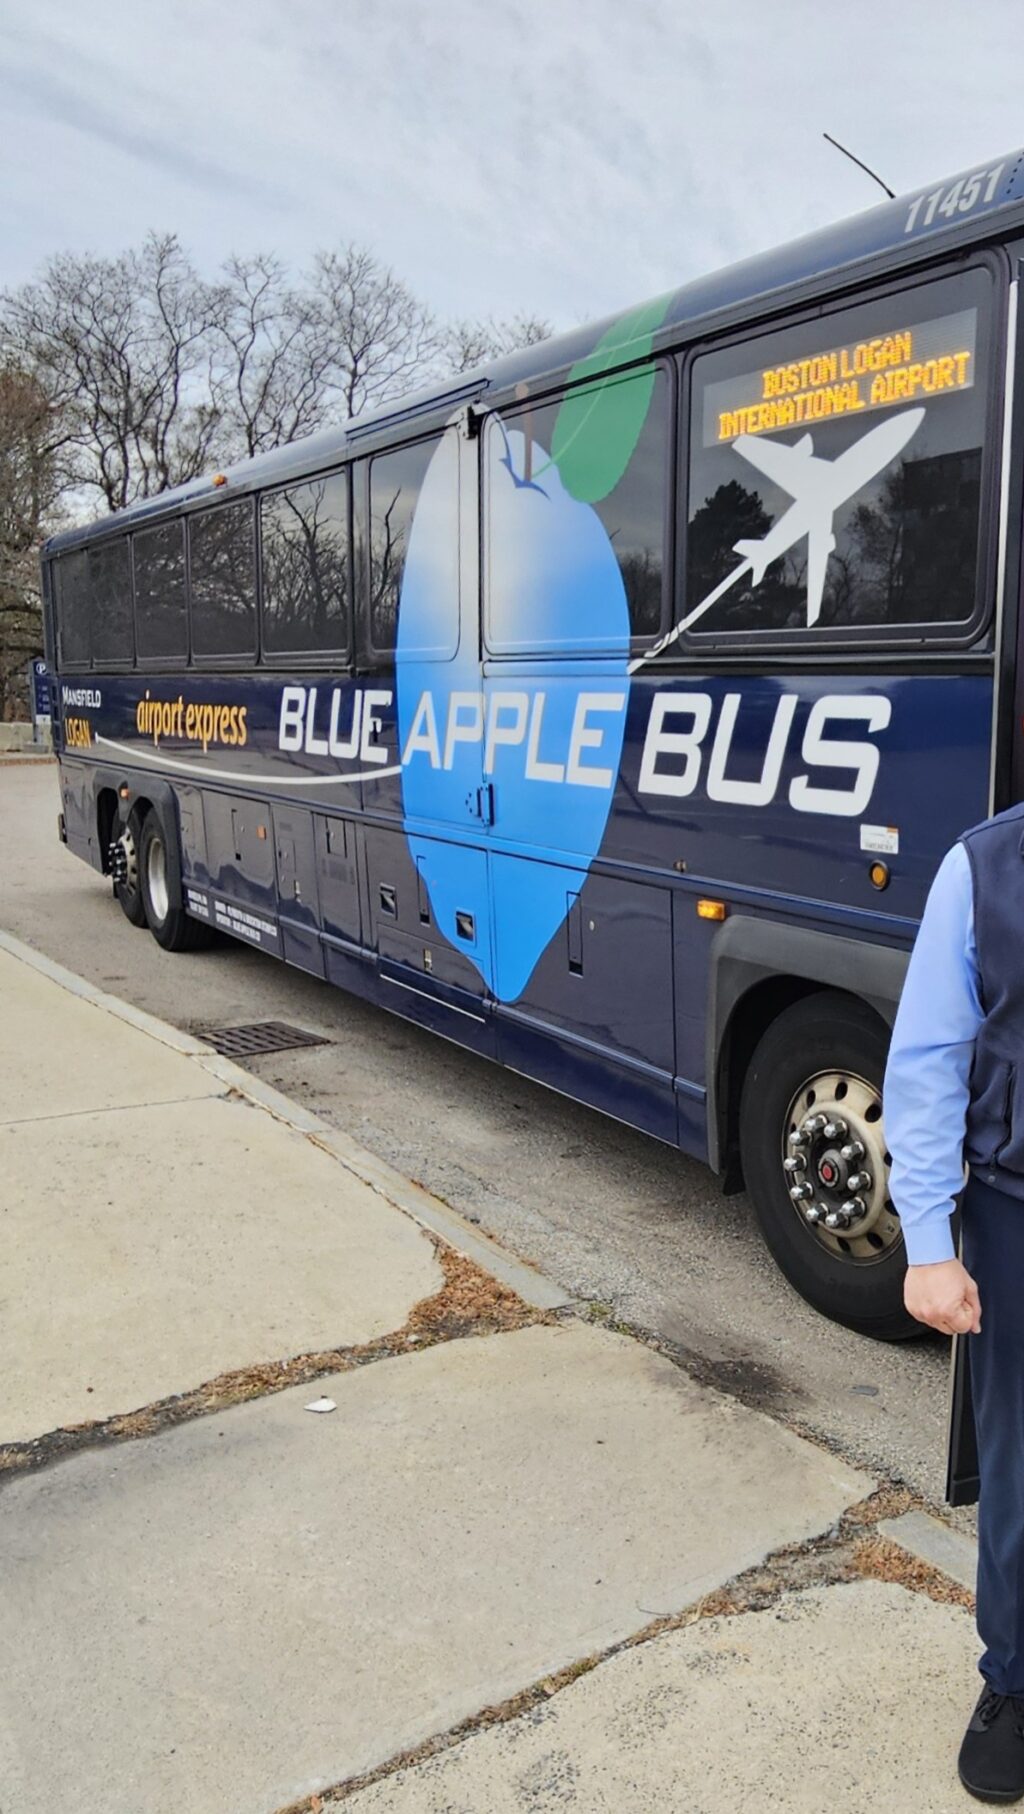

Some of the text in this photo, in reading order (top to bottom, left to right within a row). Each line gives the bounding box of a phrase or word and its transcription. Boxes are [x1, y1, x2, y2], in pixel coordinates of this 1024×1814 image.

[903, 163, 1005, 233] 11451
[719, 350, 971, 440] INTERNATIONAL AIRPORT
[762, 331, 912, 399] BOSTON LOGAN
[62, 685, 102, 708] MANSFIELD
[136, 689, 247, 753] airport express
[65, 718, 91, 748] LOGAN
[278, 686, 893, 816] BLUE APPLE BUS
